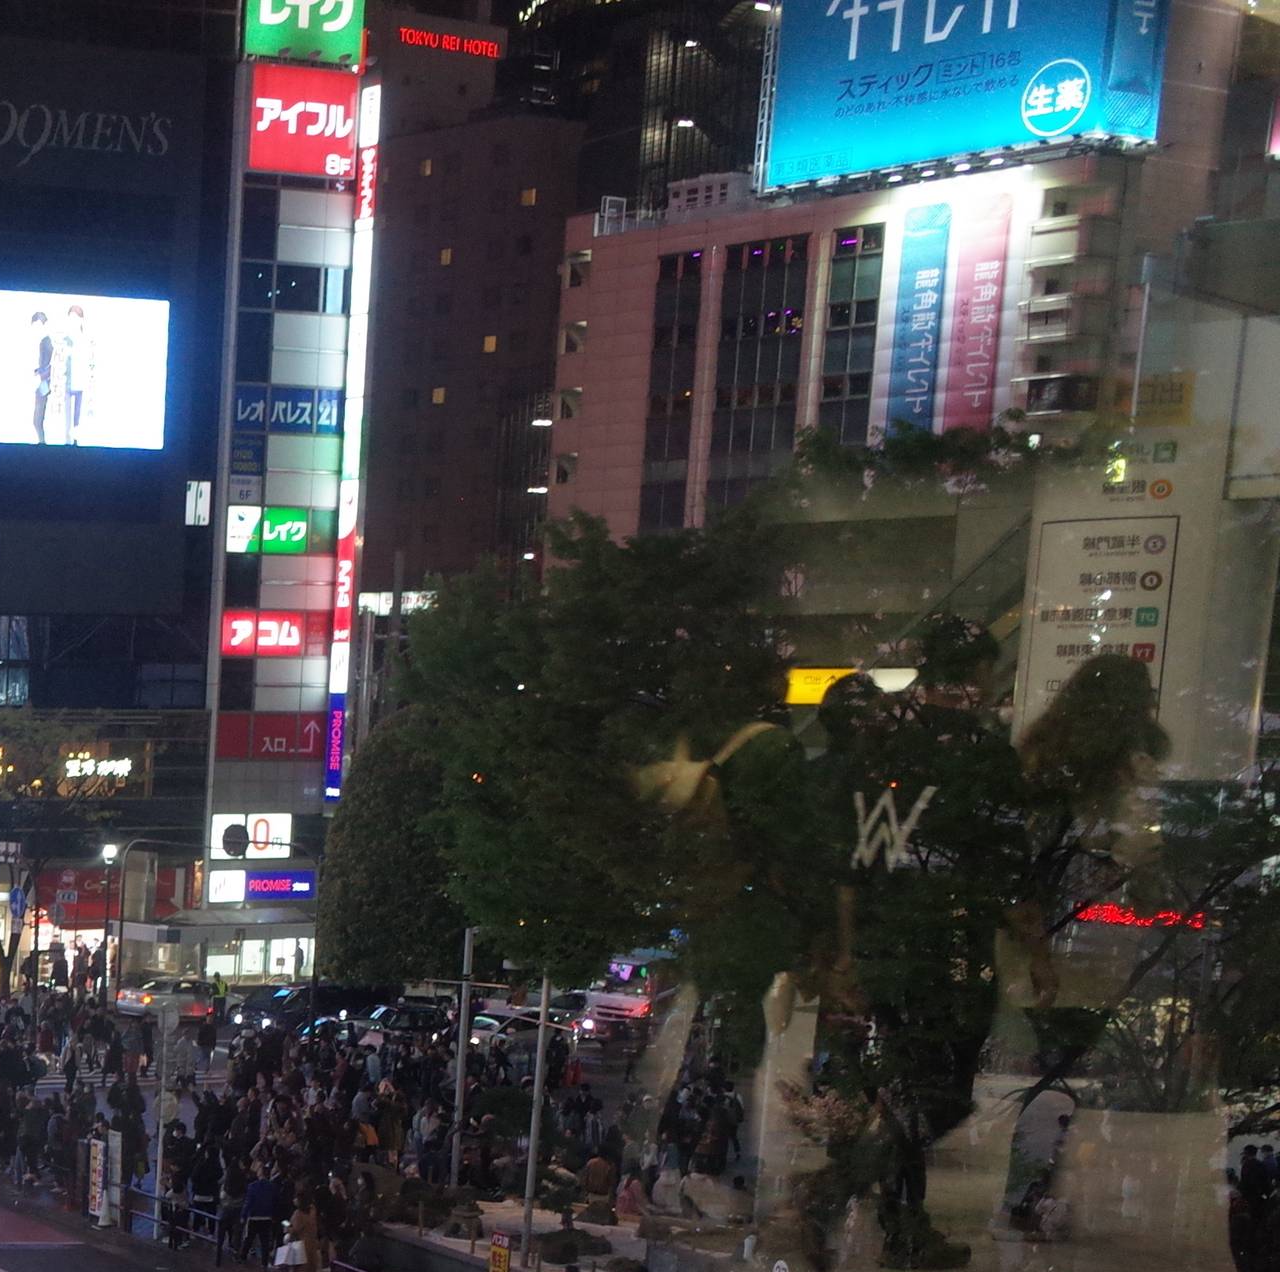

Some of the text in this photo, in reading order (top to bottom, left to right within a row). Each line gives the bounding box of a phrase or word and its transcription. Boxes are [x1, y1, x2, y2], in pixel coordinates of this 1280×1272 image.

[400, 27, 500, 58] TOKYU REI HOTEL
[837, 64, 933, 101] スティック
[1025, 76, 1086, 118] 生薬
[255, 97, 354, 138] アイフル
[325, 154, 351, 175] 8F
[263, 520, 307, 542] レイク
[336, 560, 352, 608] アコム
[230, 619, 301, 646] アコム
[262, 736, 287, 752] 入口
[329, 711, 343, 770] PROMISE
[248, 879, 291, 892] PROMISE
